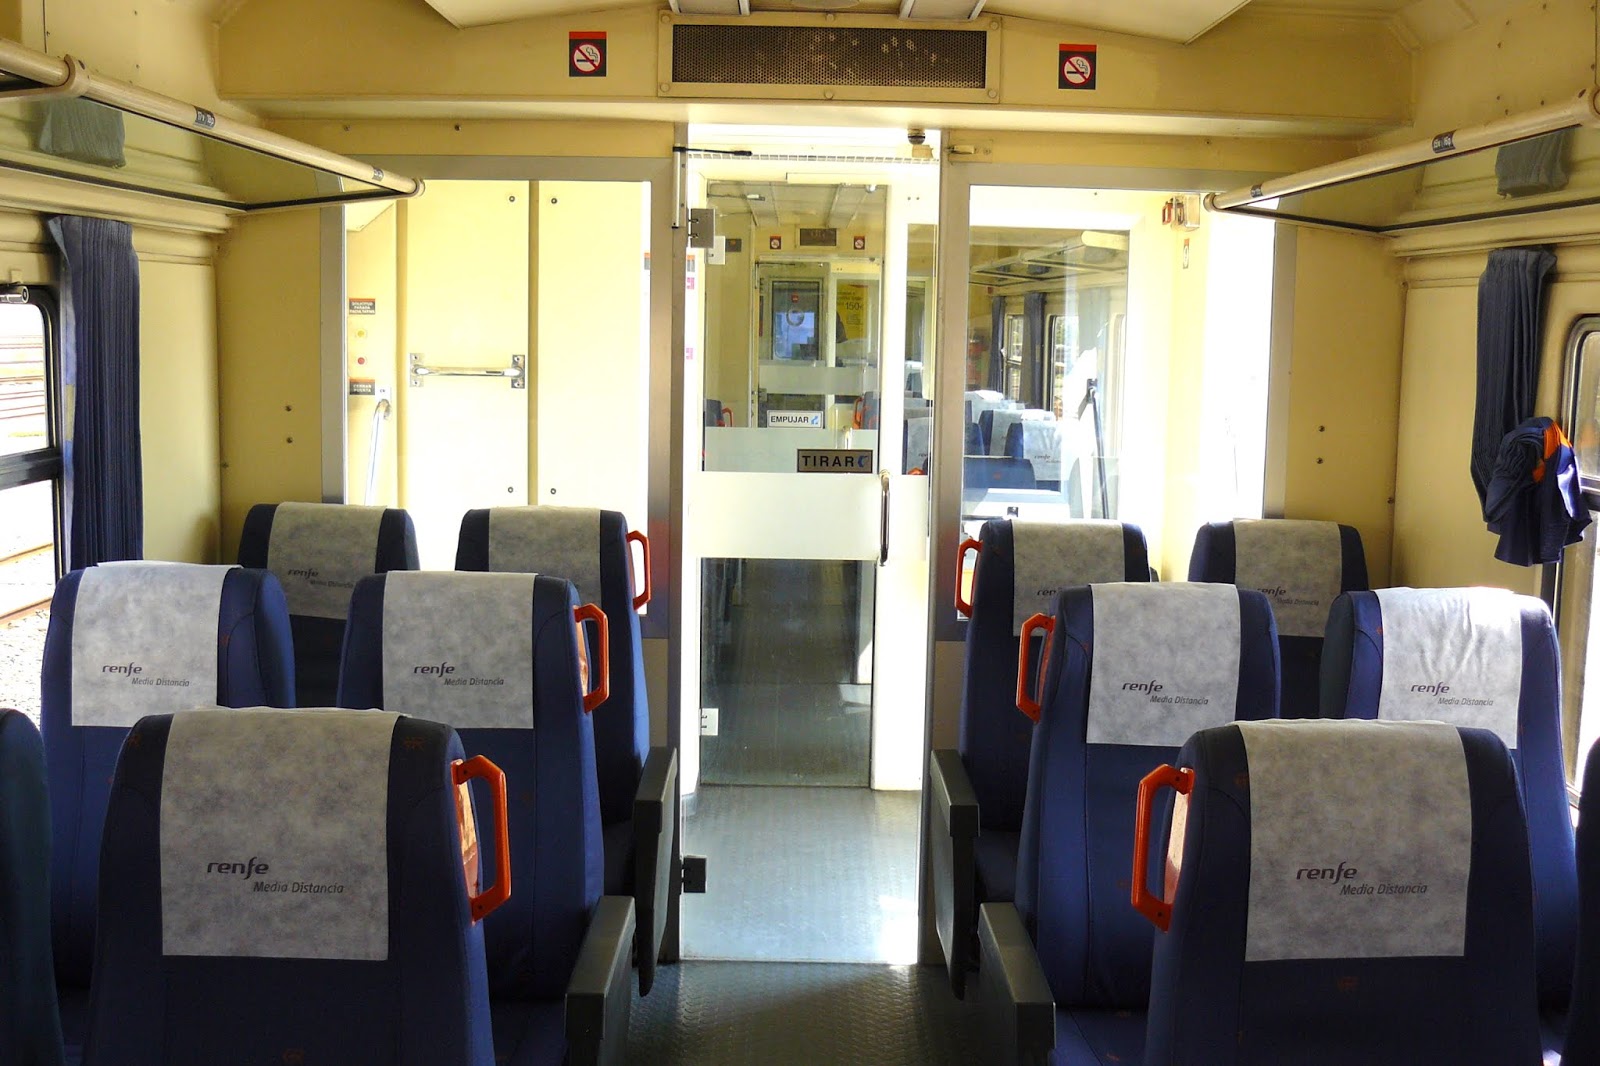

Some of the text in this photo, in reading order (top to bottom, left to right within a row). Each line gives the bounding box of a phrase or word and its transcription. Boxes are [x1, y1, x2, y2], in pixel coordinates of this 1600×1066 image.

[770, 415, 809, 424] EMPUJAR
[802, 455, 854, 468] TIRAR
[102, 662, 143, 677] renfe
[413, 661, 456, 678] renfe
[131, 677, 190, 687] Media Distancia
[444, 677, 505, 686] Media Distancia
[1122, 680, 1163, 695] renfe
[1410, 682, 1450, 697] renfe
[1150, 695, 1209, 705] Media Distancia
[1438, 697, 1494, 706] Media Distancia
[207, 856, 270, 880] renfe
[1296, 861, 1358, 885] renfe
[253, 881, 345, 894] Media Distancia
[1340, 883, 1428, 896] Media Distancia
